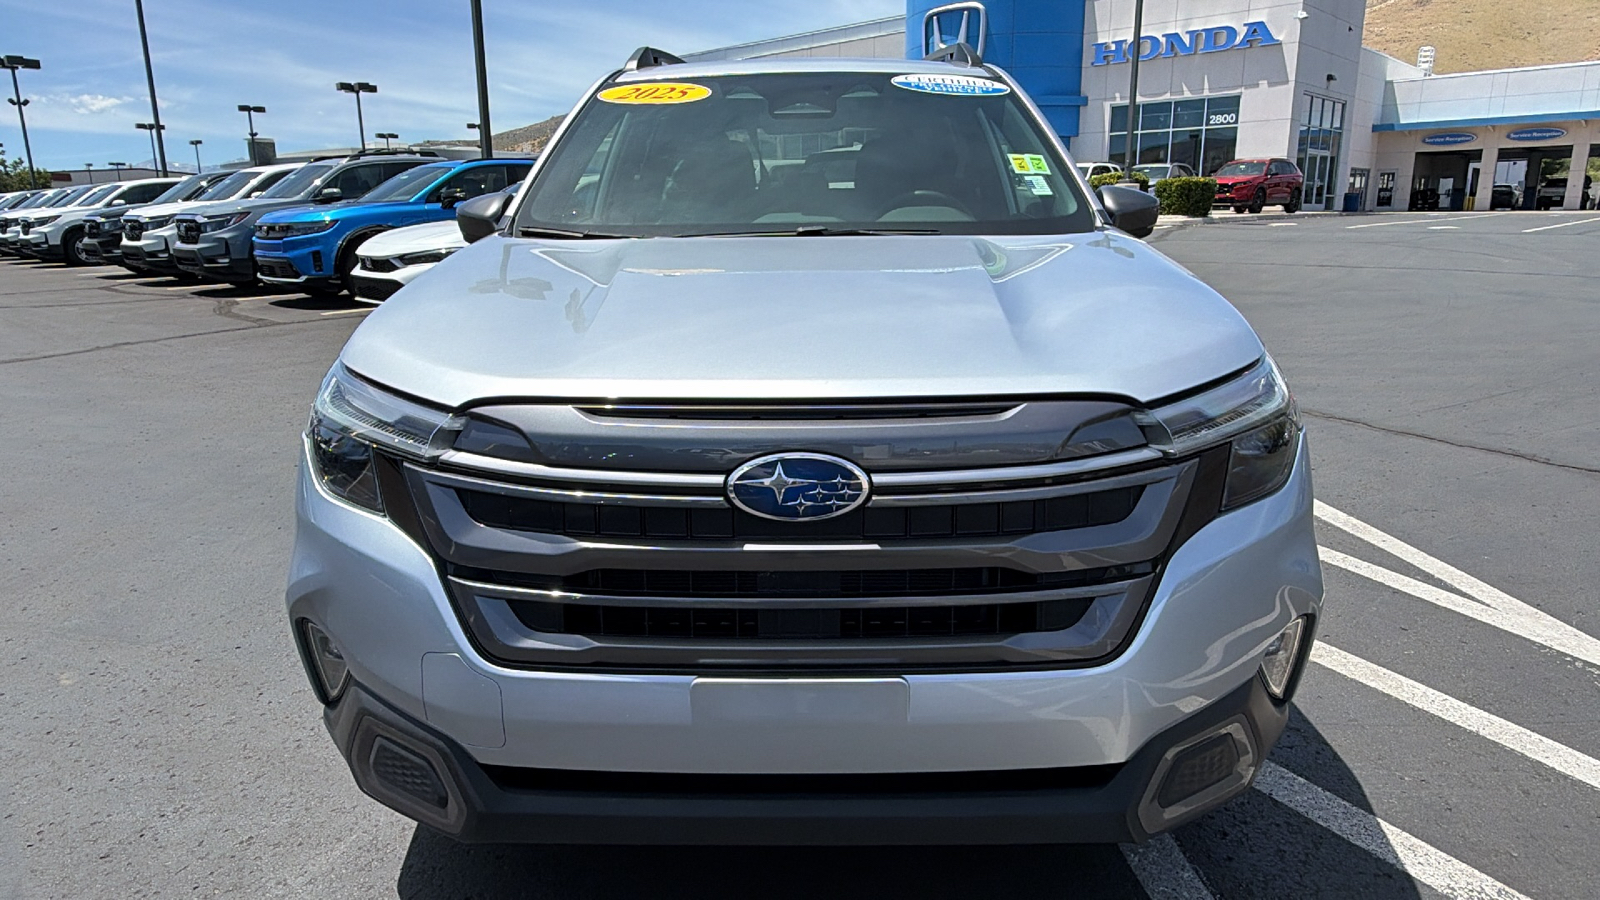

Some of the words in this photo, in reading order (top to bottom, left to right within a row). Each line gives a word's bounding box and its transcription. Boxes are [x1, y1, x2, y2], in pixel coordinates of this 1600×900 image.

[1091, 20, 1282, 66] HONDA
[904, 76, 995, 87] CERTIFIED
[613, 87, 696, 100] 2025
[924, 85, 984, 94] VEHICLE
[1209, 113, 1236, 124] 2800
